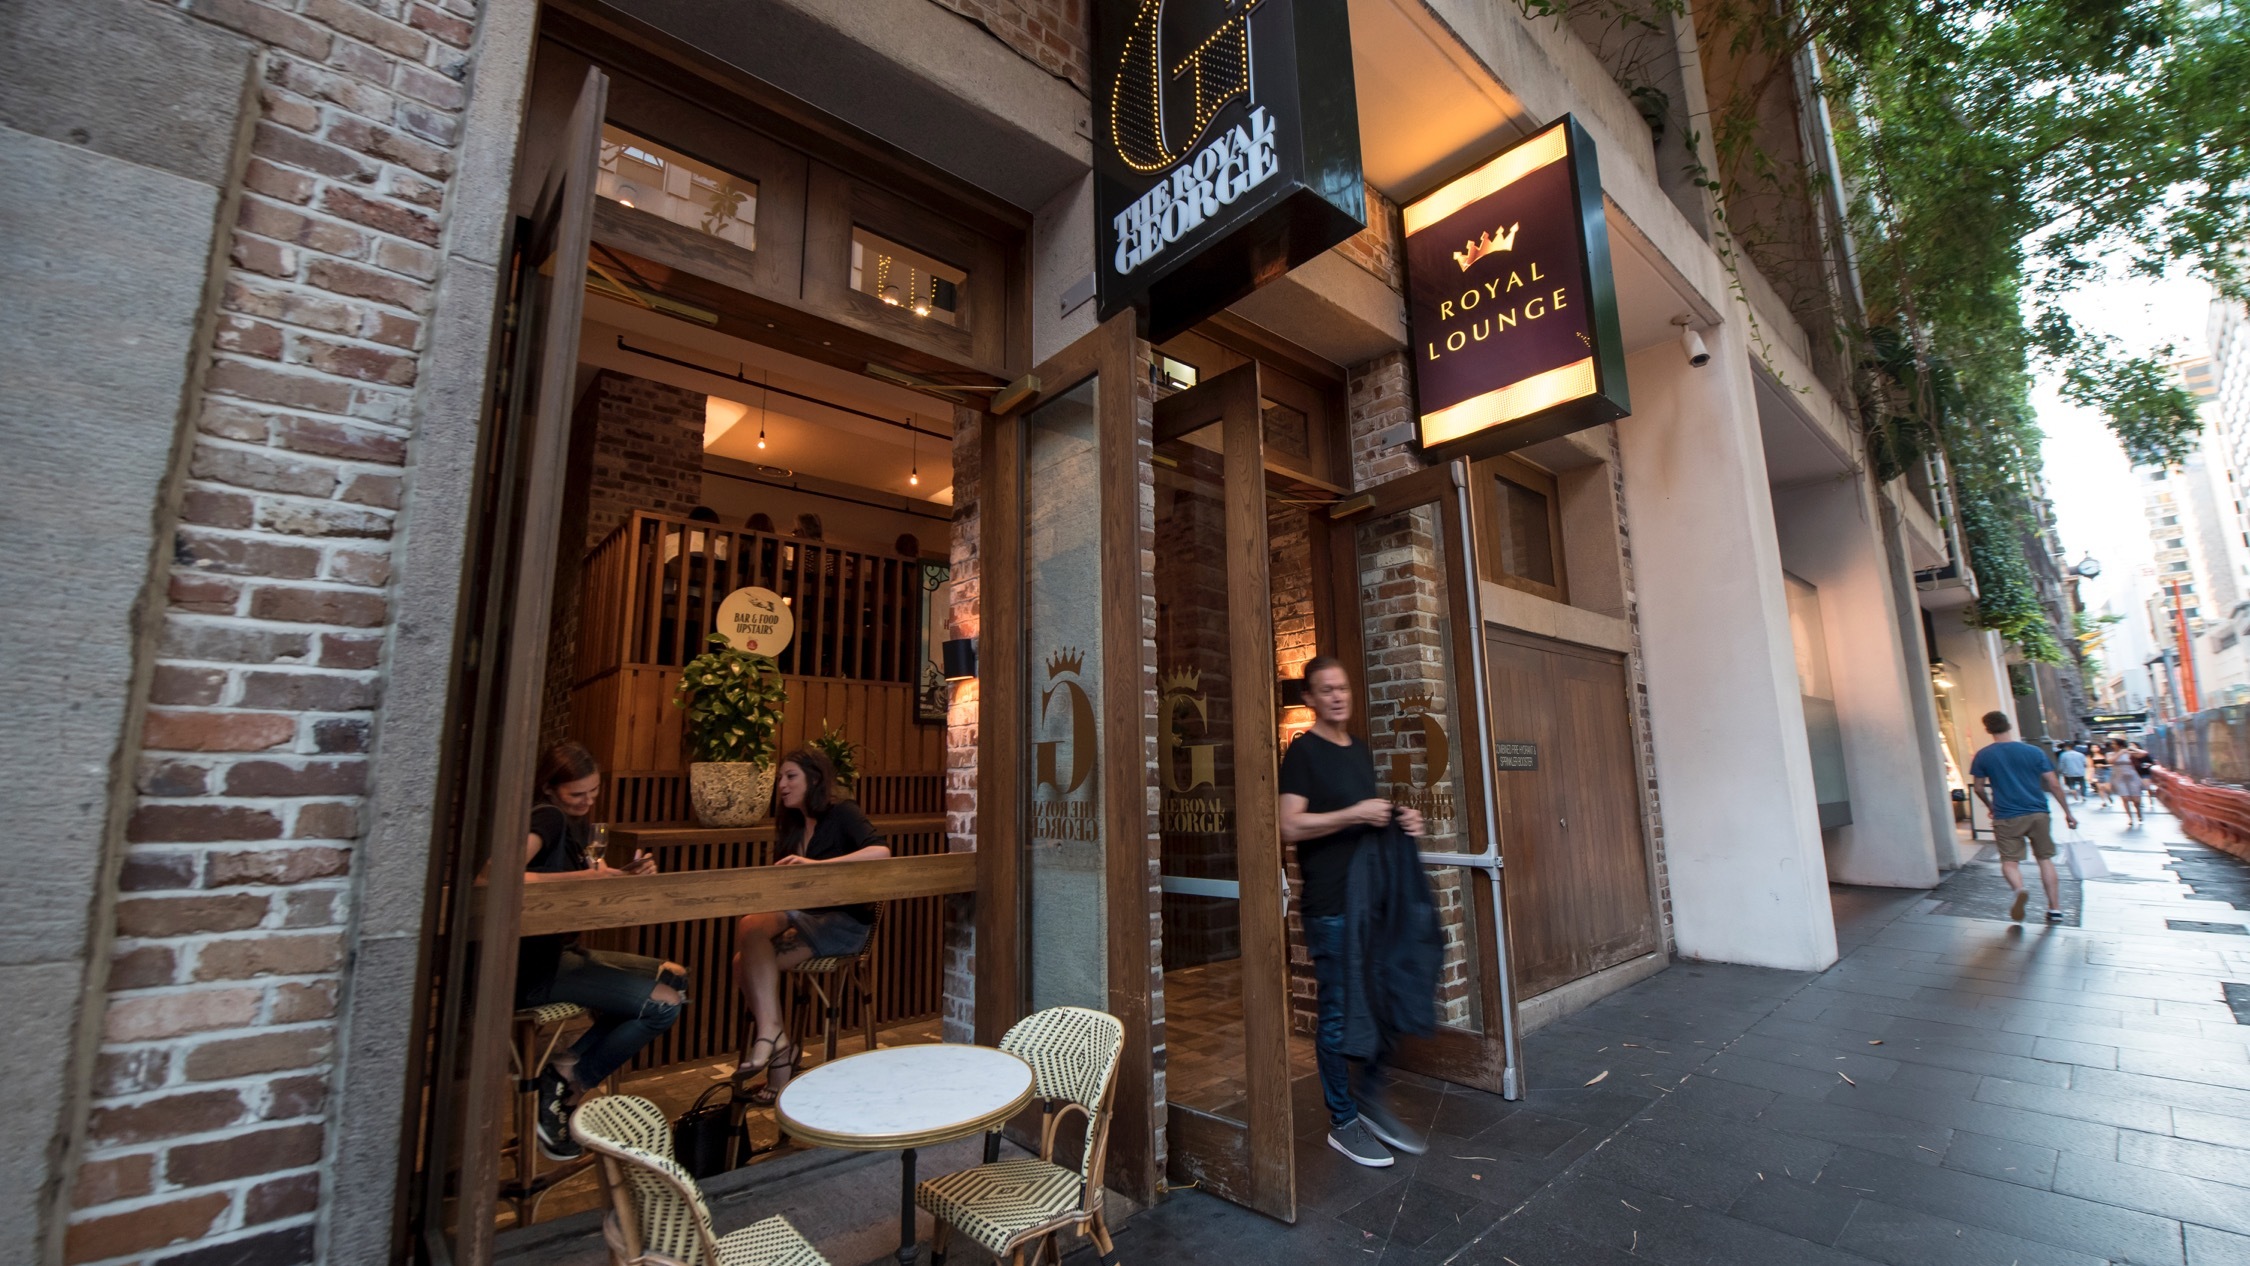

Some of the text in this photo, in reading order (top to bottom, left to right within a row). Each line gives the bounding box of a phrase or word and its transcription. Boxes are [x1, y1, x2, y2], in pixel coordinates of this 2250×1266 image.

[1114, 106, 1275, 242] THE ROYAL
[1115, 133, 1279, 275] GEORGE
[1440, 262, 1545, 321] ROYAL
[1428, 287, 1567, 361] LOUNGE
[734, 612, 779, 625] BAR & FOOD
[736, 623, 774, 635] UPSTAIRS
[1160, 812, 1226, 833] EORGE
[1180, 798, 1225, 812] ROYAL
